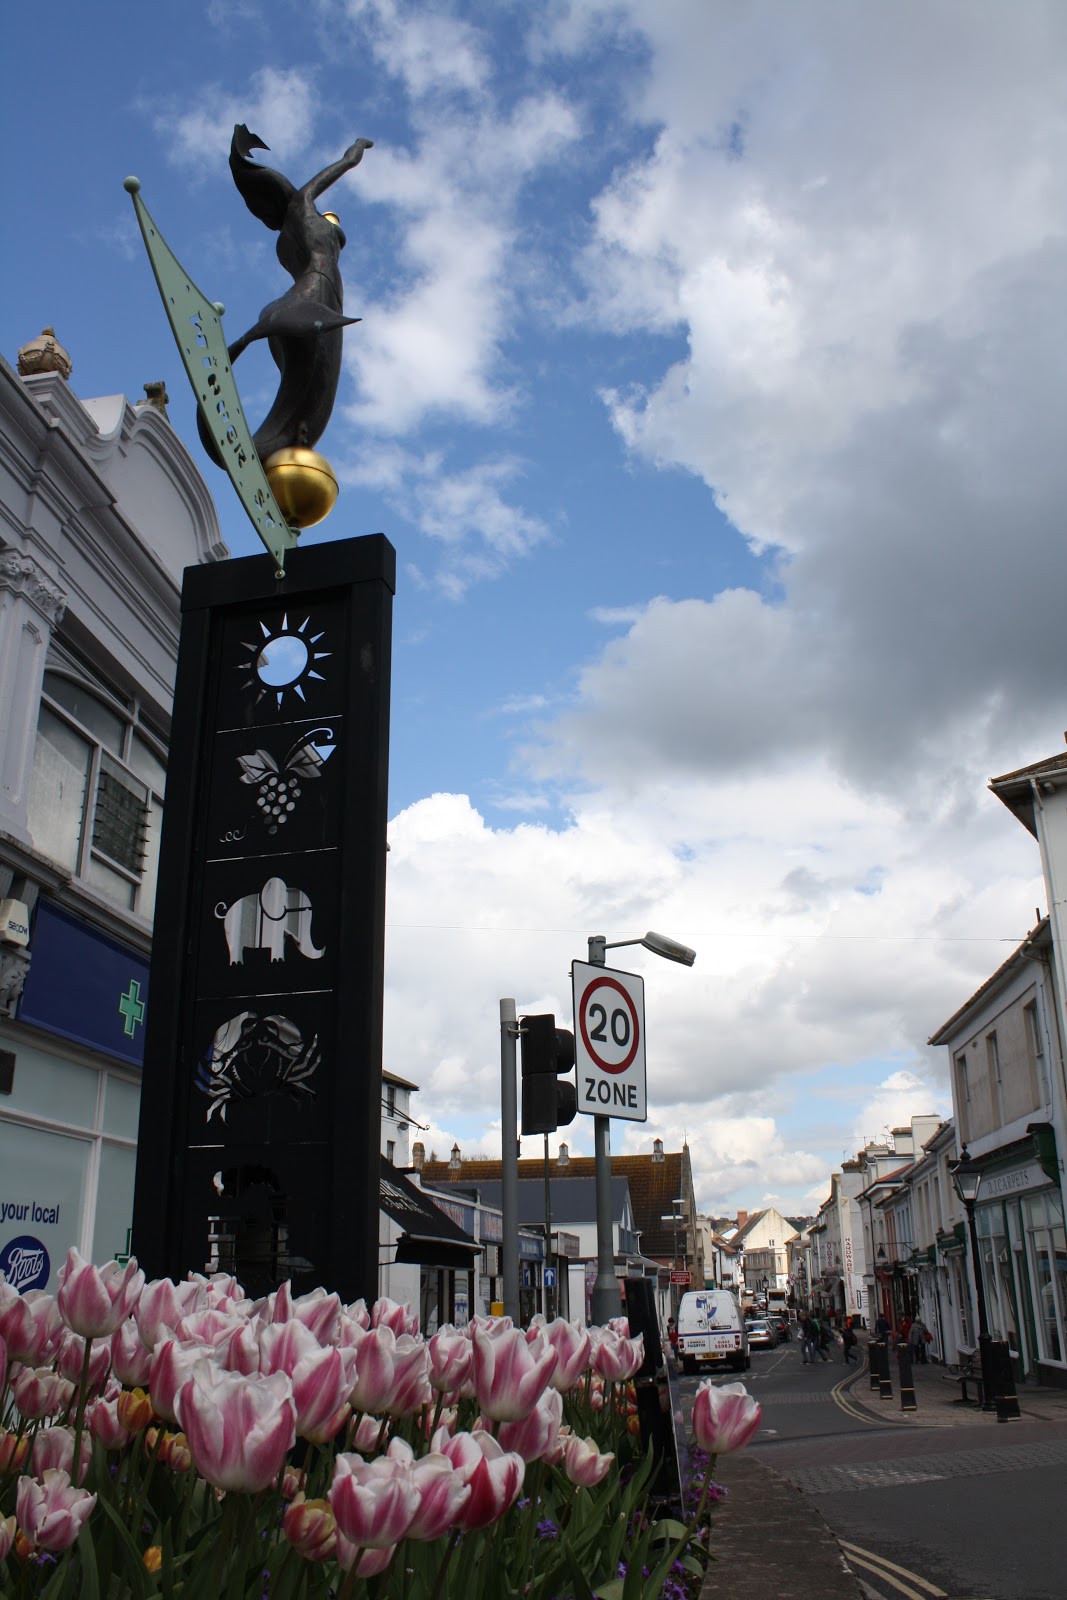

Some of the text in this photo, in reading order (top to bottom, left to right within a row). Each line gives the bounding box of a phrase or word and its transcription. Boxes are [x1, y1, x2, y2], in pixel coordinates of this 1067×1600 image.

[588, 1003, 630, 1047] 20
[585, 1077, 638, 1109] ZONE
[0, 1201, 60, 1225] your local
[6, 1247, 45, 1291] Boots
[845, 1237, 853, 1272] HARDWARE
